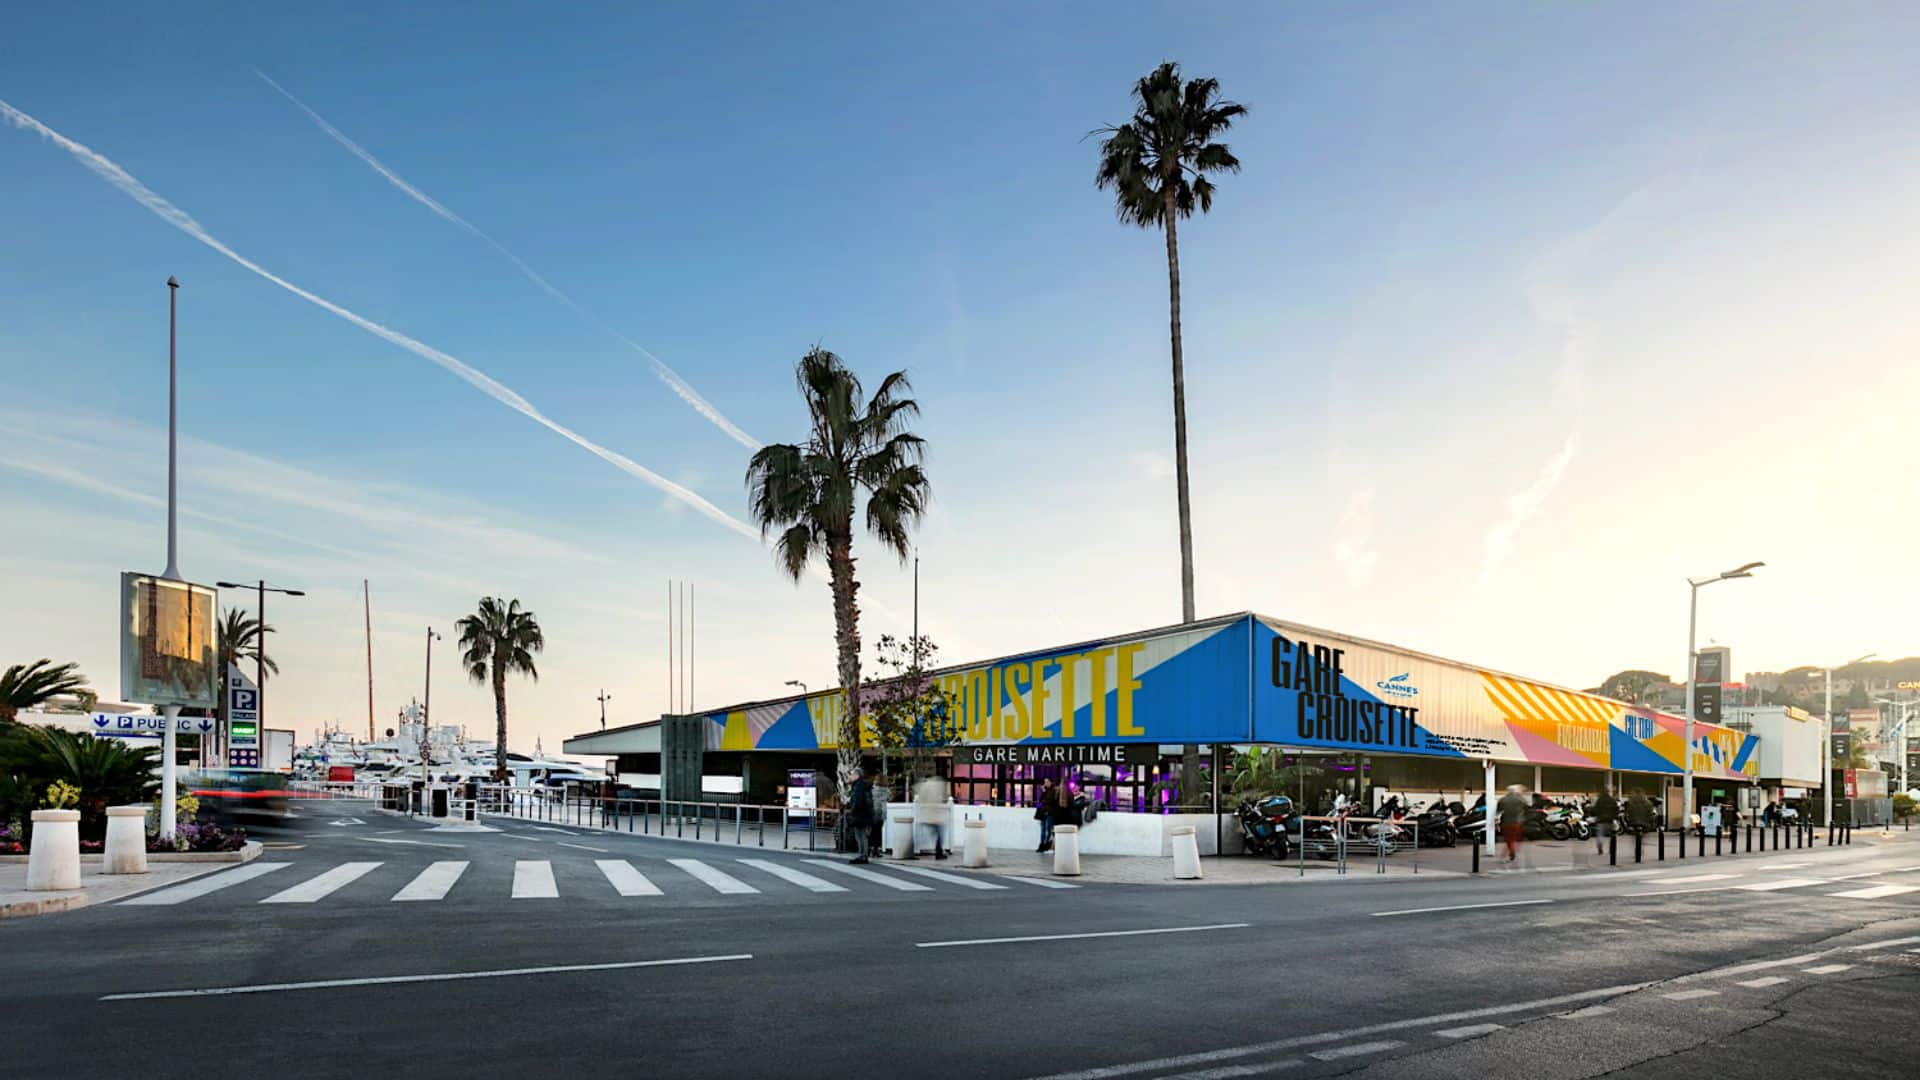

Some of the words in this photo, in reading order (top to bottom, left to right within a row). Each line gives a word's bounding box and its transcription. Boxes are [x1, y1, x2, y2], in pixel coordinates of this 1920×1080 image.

[1271, 635, 1345, 697] GARE
[1376, 681, 1418, 695] CANNES
[137, 719, 191, 730] PUBIC
[1297, 691, 1419, 748] CROISETTE
[973, 747, 1017, 761] GARE
[1027, 745, 1126, 761] MARITIME
